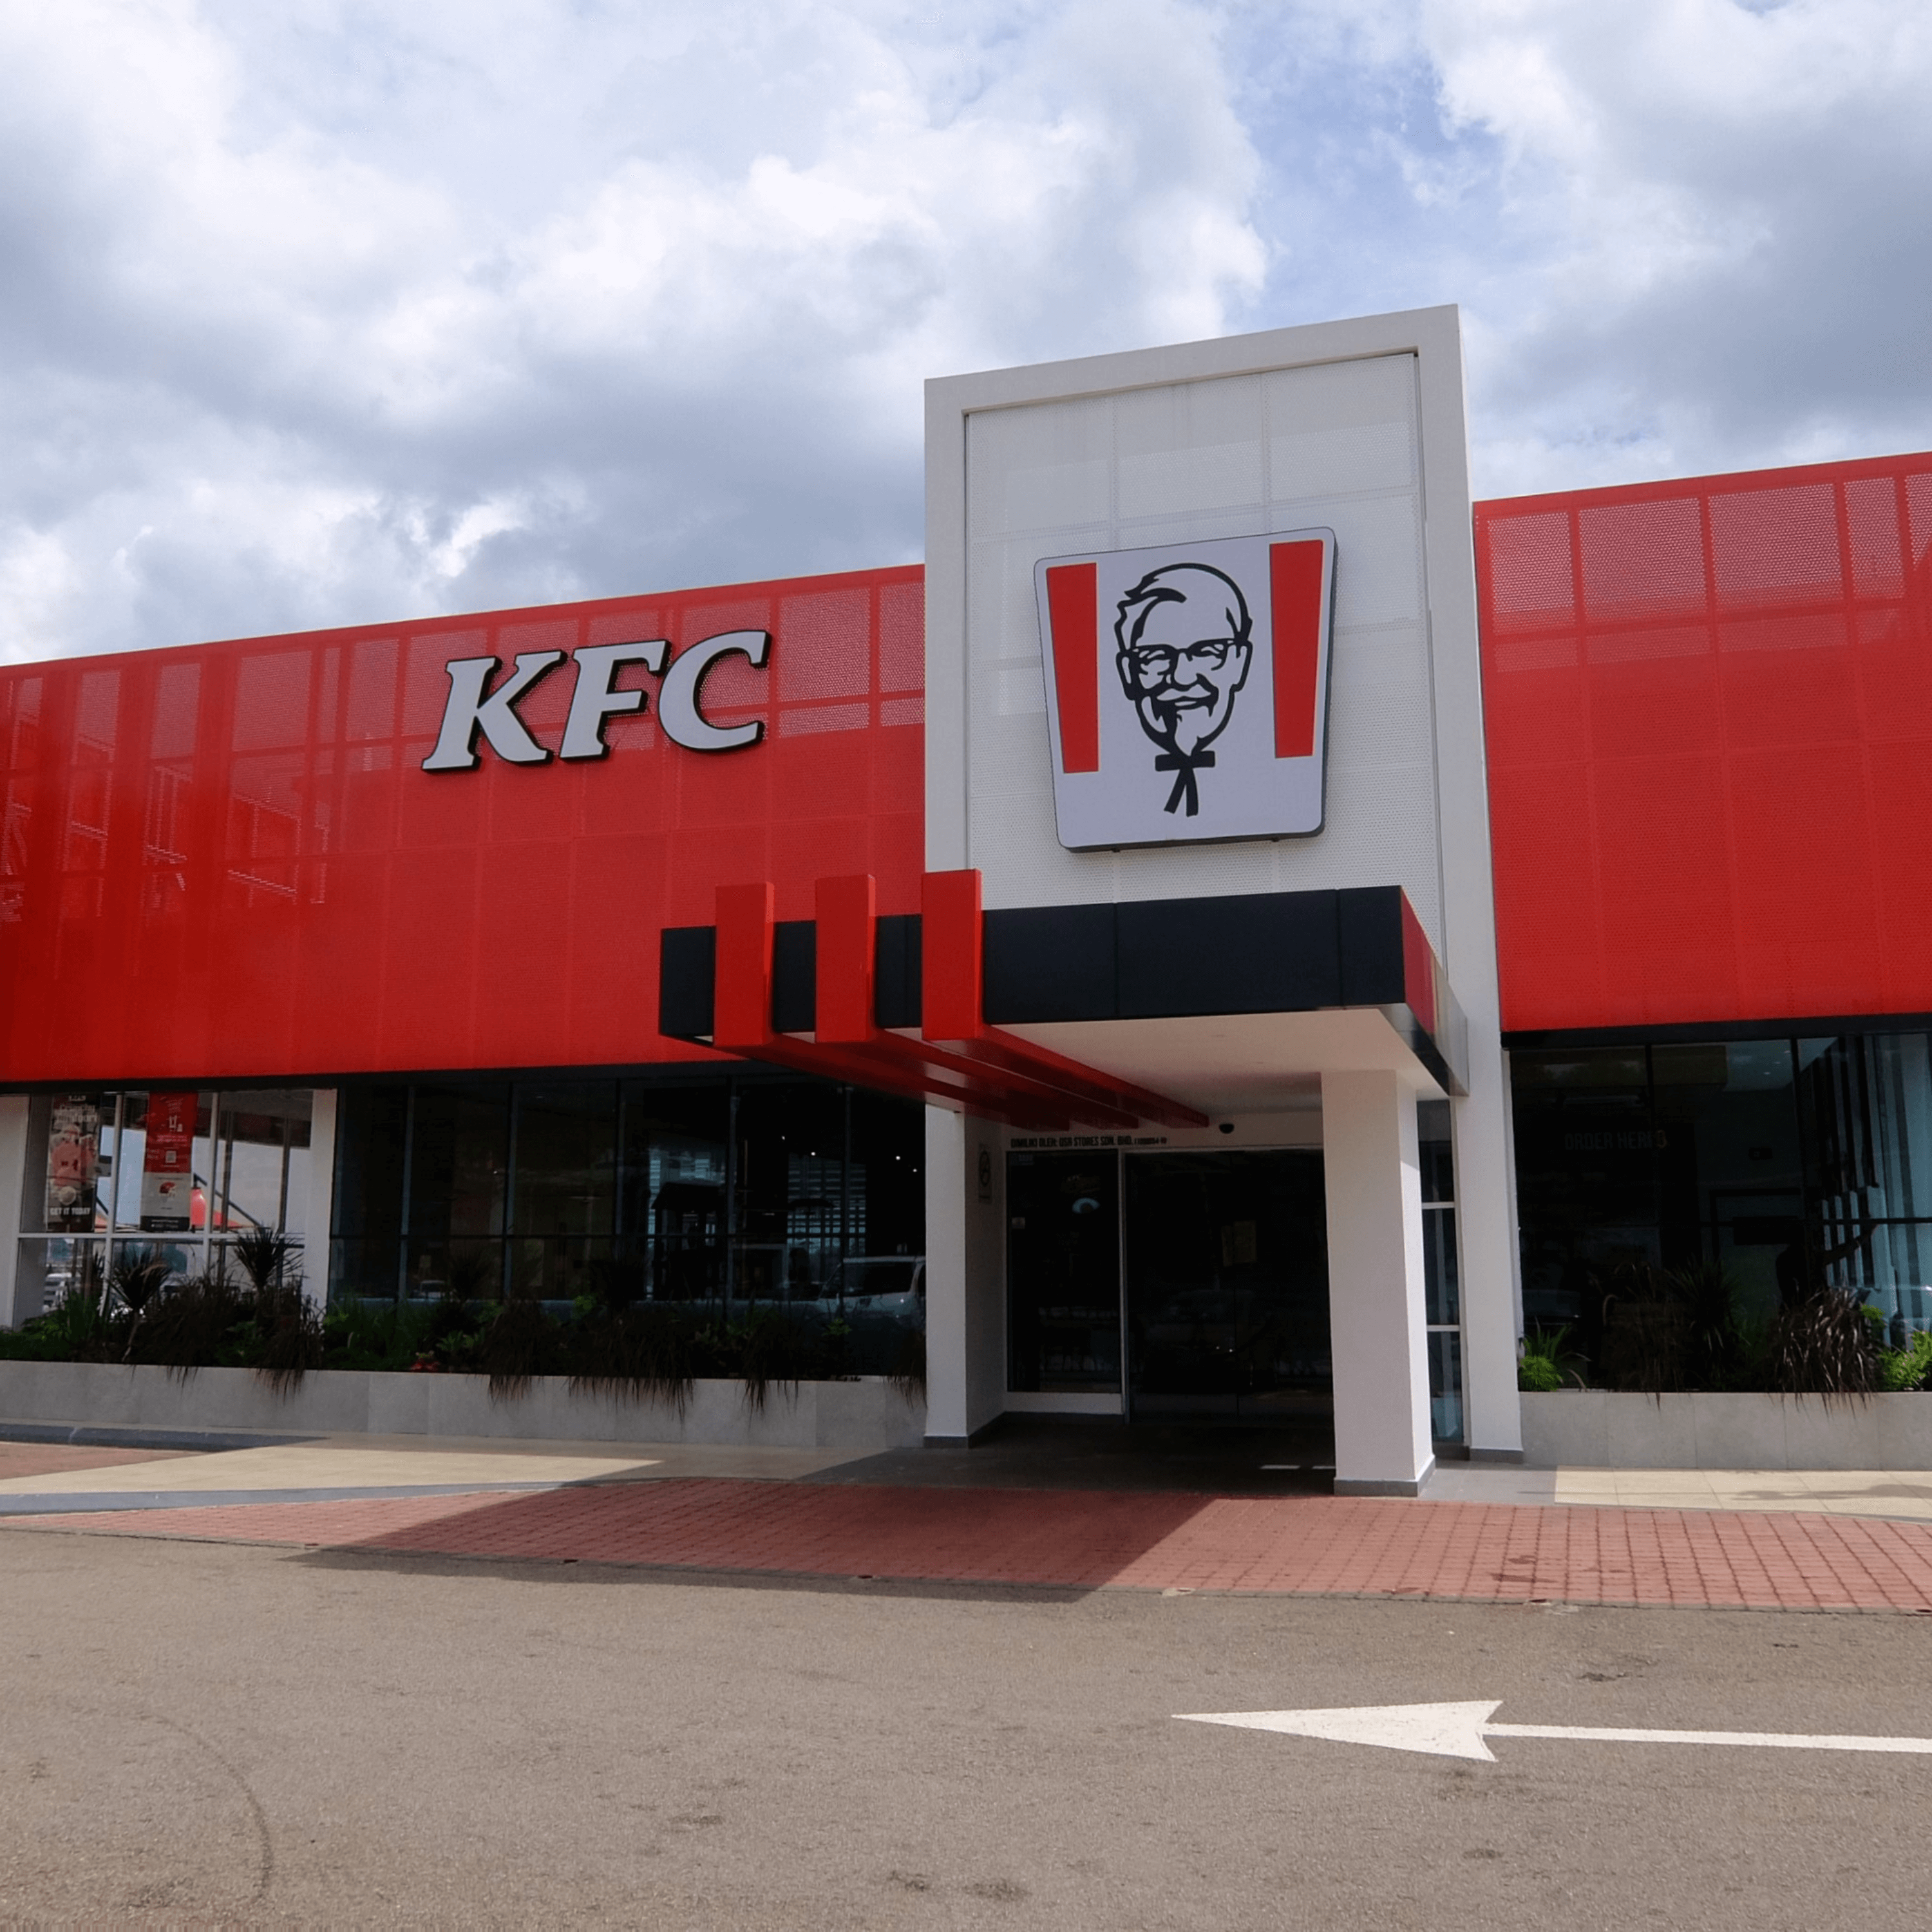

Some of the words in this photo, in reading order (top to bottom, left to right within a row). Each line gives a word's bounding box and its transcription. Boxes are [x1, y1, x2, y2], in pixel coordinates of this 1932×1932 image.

[422, 630, 771, 772] KFC
[1059, 1137, 1072, 1147] QSR
[1074, 1136, 1099, 1146] STORES
[1565, 1132, 1613, 1150] ORDER
[71, 1207, 91, 1215] TODAY
